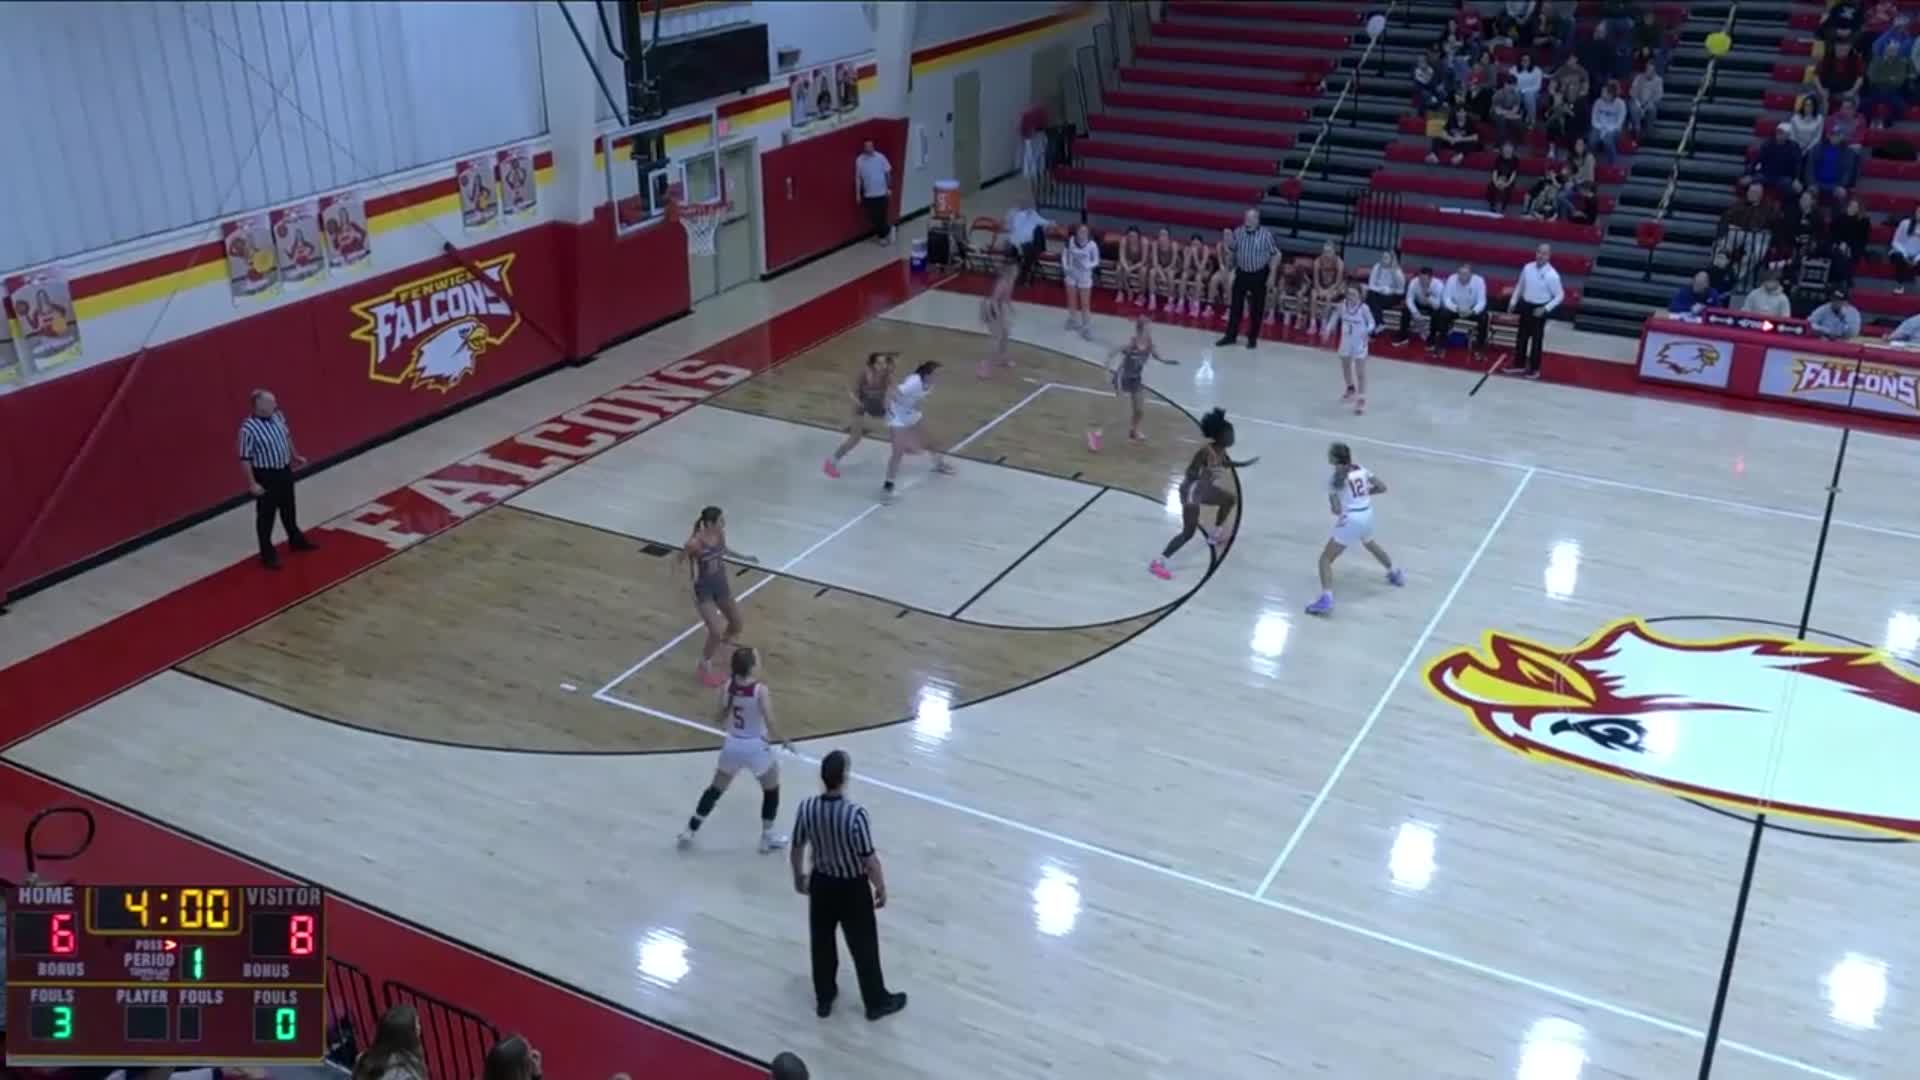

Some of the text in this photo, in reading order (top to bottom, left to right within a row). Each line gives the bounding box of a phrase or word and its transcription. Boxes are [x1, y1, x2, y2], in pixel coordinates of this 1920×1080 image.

[1797, 361, 1916, 407] FALCONS
[319, 360, 752, 549] FALCONS
[1350, 478, 1365, 498] 12
[733, 706, 745, 730] 5
